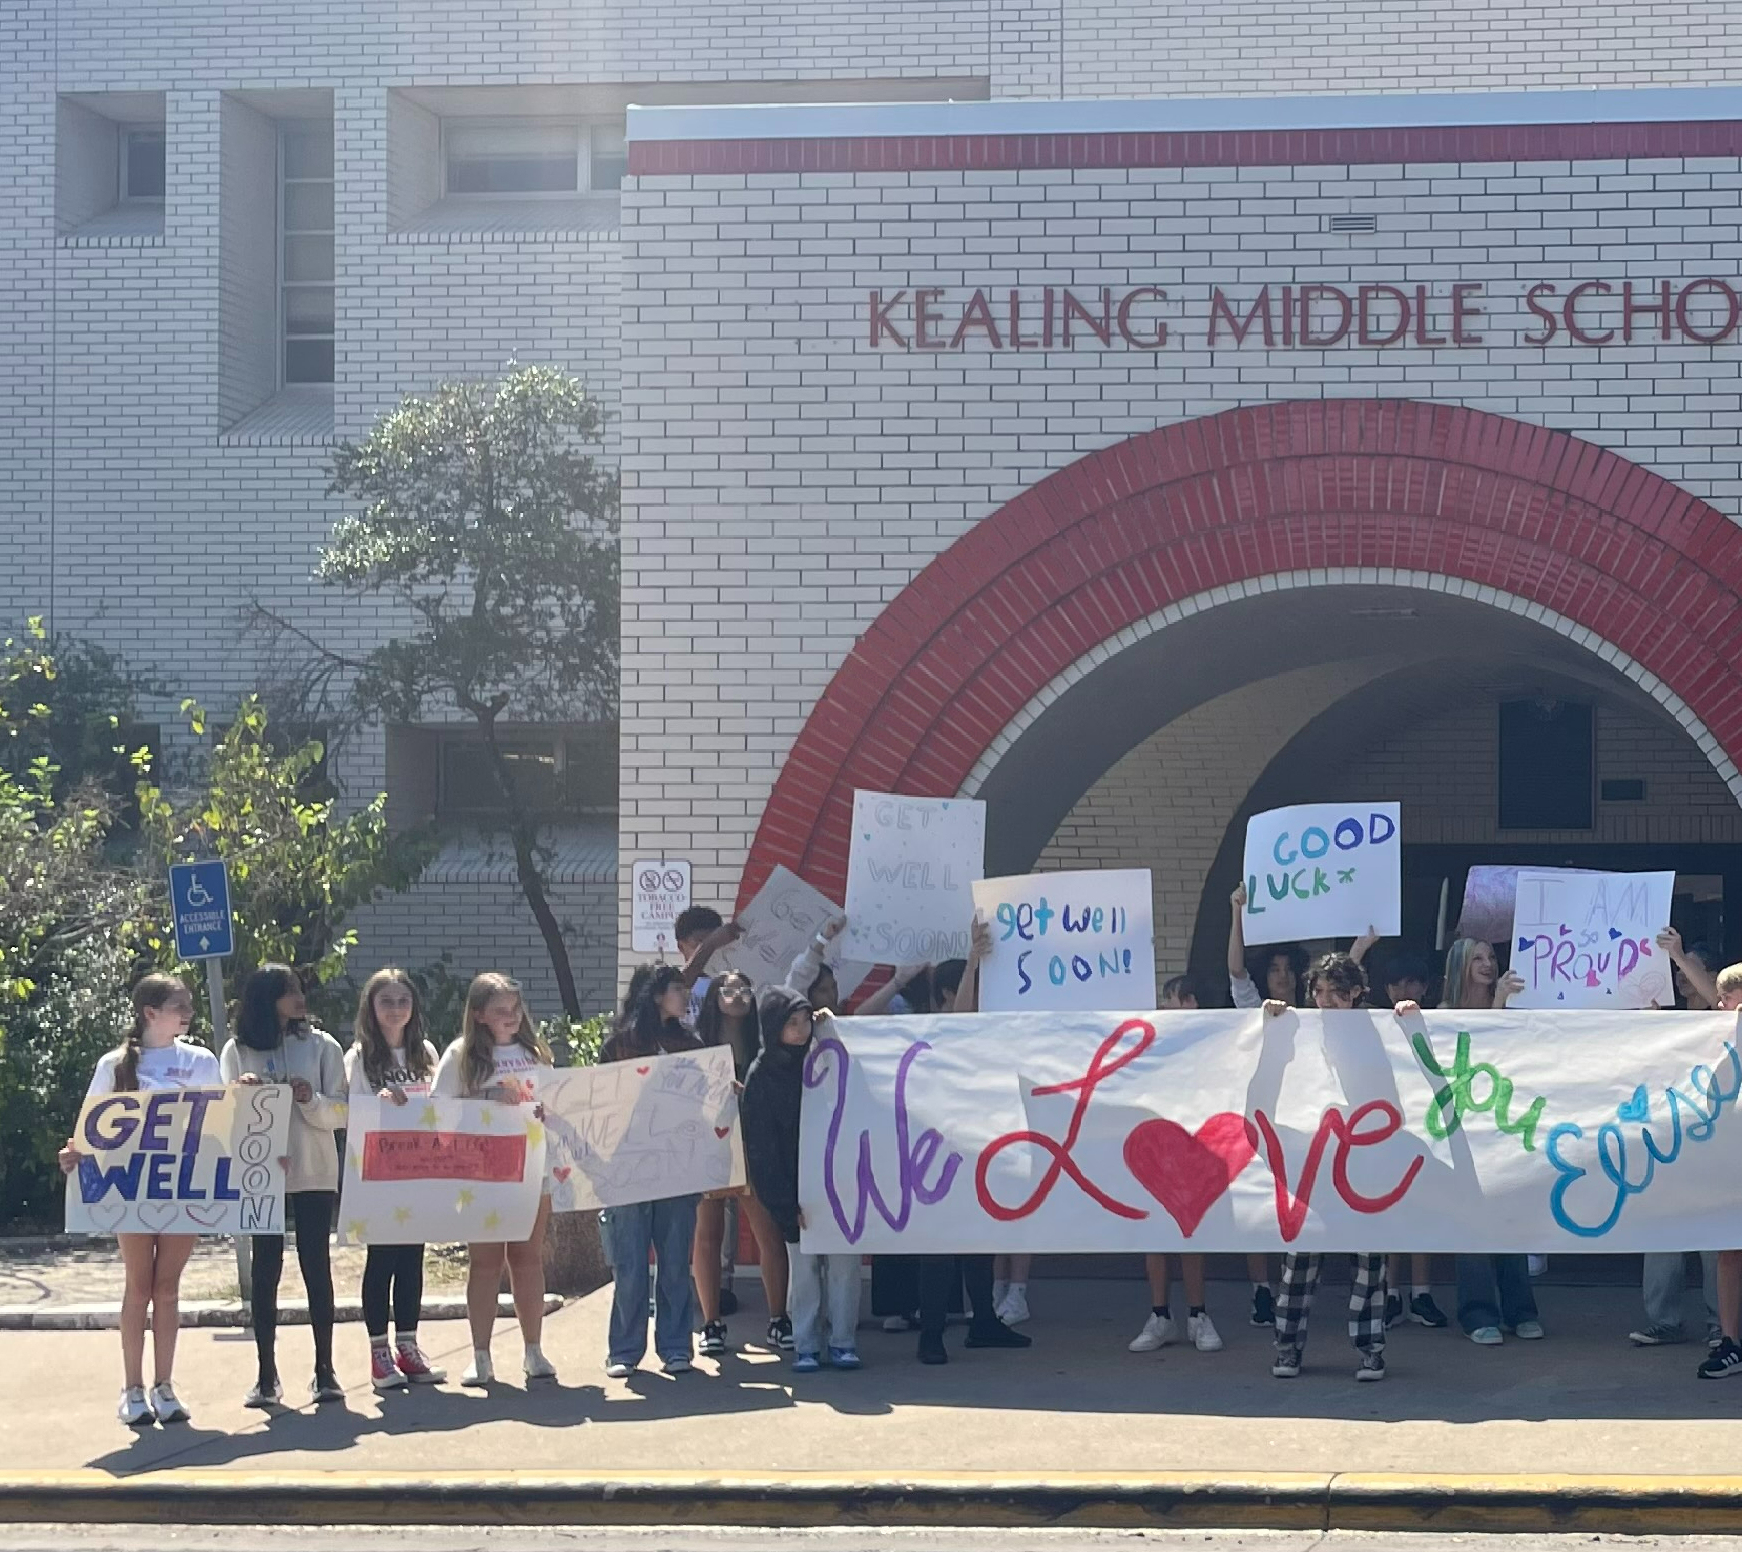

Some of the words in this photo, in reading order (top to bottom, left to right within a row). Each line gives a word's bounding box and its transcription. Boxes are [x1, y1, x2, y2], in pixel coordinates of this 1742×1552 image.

[868, 287, 1168, 349] KEALING
[1207, 284, 1484, 348] MIDDLE
[875, 800, 938, 830] GET
[1273, 813, 1395, 866] GOOD
[867, 858, 958, 891] WELL
[180, 910, 226, 923] ACCESSIBLE
[183, 921, 222, 934] ENTRANCE
[997, 897, 1054, 941] get
[1062, 904, 1126, 934] well
[1517, 878, 1564, 926] I
[1585, 879, 1648, 927] AM
[1534, 935, 1639, 989] PROUD
[84, 1089, 226, 1154] GET
[803, 1038, 963, 1244] We
[1412, 1031, 1546, 1152] You
[1545, 1041, 1742, 1238] Elise
[78, 1152, 240, 1204] WELL
[239, 1088, 280, 1230] SOON
